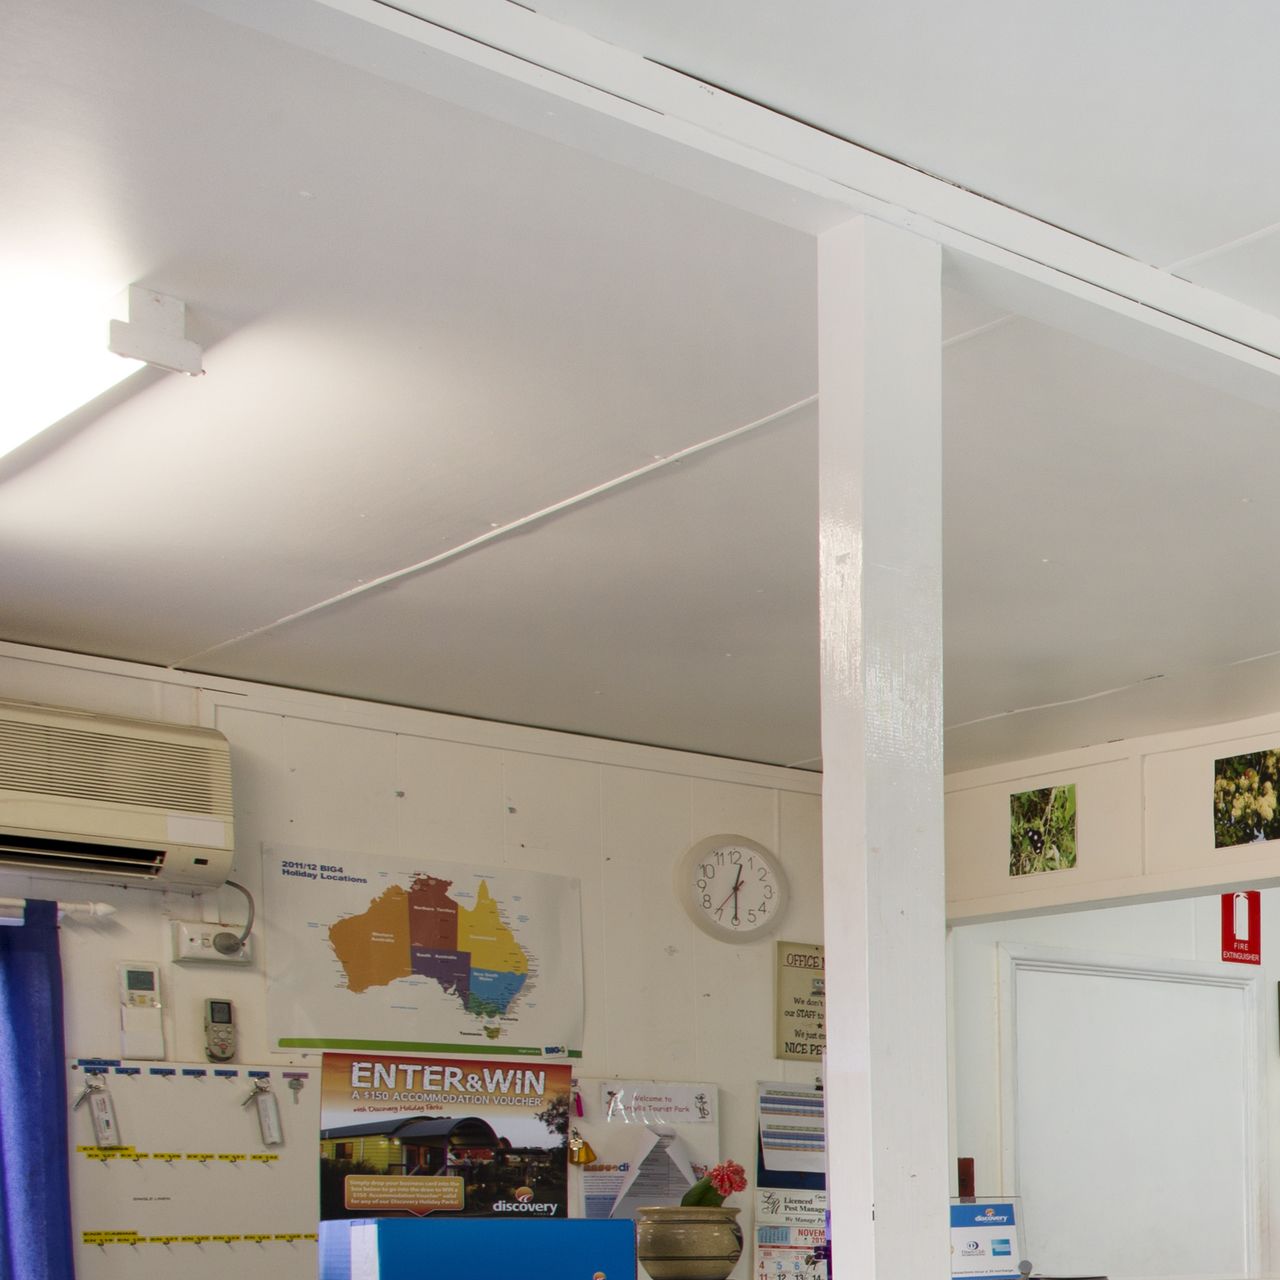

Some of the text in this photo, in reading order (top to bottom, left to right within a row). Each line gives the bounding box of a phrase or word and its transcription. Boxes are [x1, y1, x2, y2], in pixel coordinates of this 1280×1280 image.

[714, 852, 724, 866] 11
[728, 851, 742, 865] 12
[748, 857, 752, 870] 1
[282, 861, 343, 874] 2011/12 BIG4
[699, 864, 715, 879] 10
[282, 868, 367, 884] Holiday Locations
[758, 868, 767, 881] 2
[697, 879, 706, 892] 9
[764, 885, 772, 900] 3
[703, 894, 711, 909] 8
[758, 902, 766, 914] 4
[748, 910, 756, 923] 5
[787, 953, 820, 968] OFFICE
[1223, 951, 1260, 961] EXTINGUISHER
[793, 997, 824, 1006] We don't
[784, 1009, 795, 1017] our
[796, 1009, 816, 1019] STAFF
[794, 1029, 805, 1038] We
[806, 1030, 817, 1041] just
[785, 1042, 807, 1054] NICE
[351, 1061, 545, 1095] ENTER&WIN
[352, 1092, 360, 1100] A
[364, 1091, 388, 1101] $150
[393, 1092, 489, 1105] ACCOMMODATION
[493, 1200, 558, 1215] discovery
[760, 1261, 800, 1270] 4 5 6
